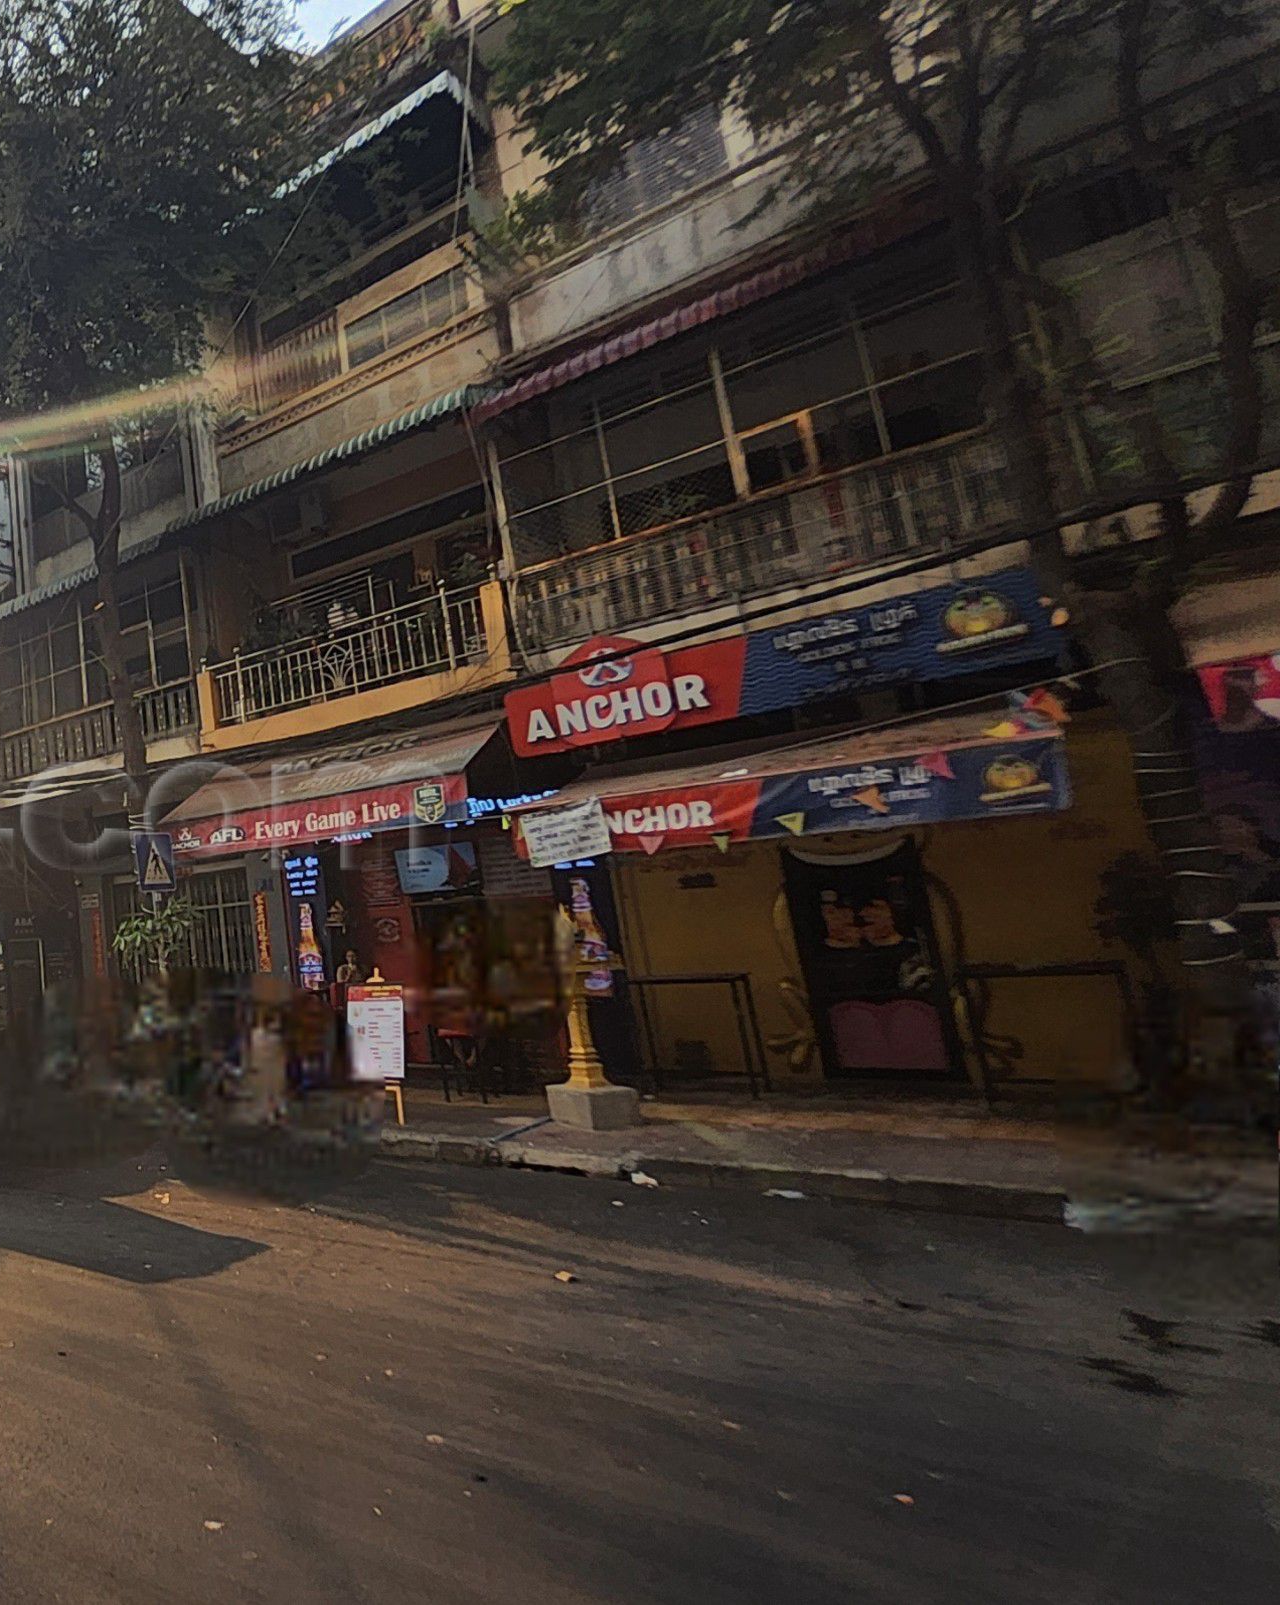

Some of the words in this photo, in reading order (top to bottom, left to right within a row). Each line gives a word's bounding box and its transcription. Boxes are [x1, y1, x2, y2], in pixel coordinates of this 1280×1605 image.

[526, 673, 712, 743] ANCHOR
[209, 827, 243, 844] AFL
[254, 819, 300, 841] Every
[305, 808, 357, 832] Game
[362, 799, 402, 825] Live
[606, 800, 715, 835] NCHOR
